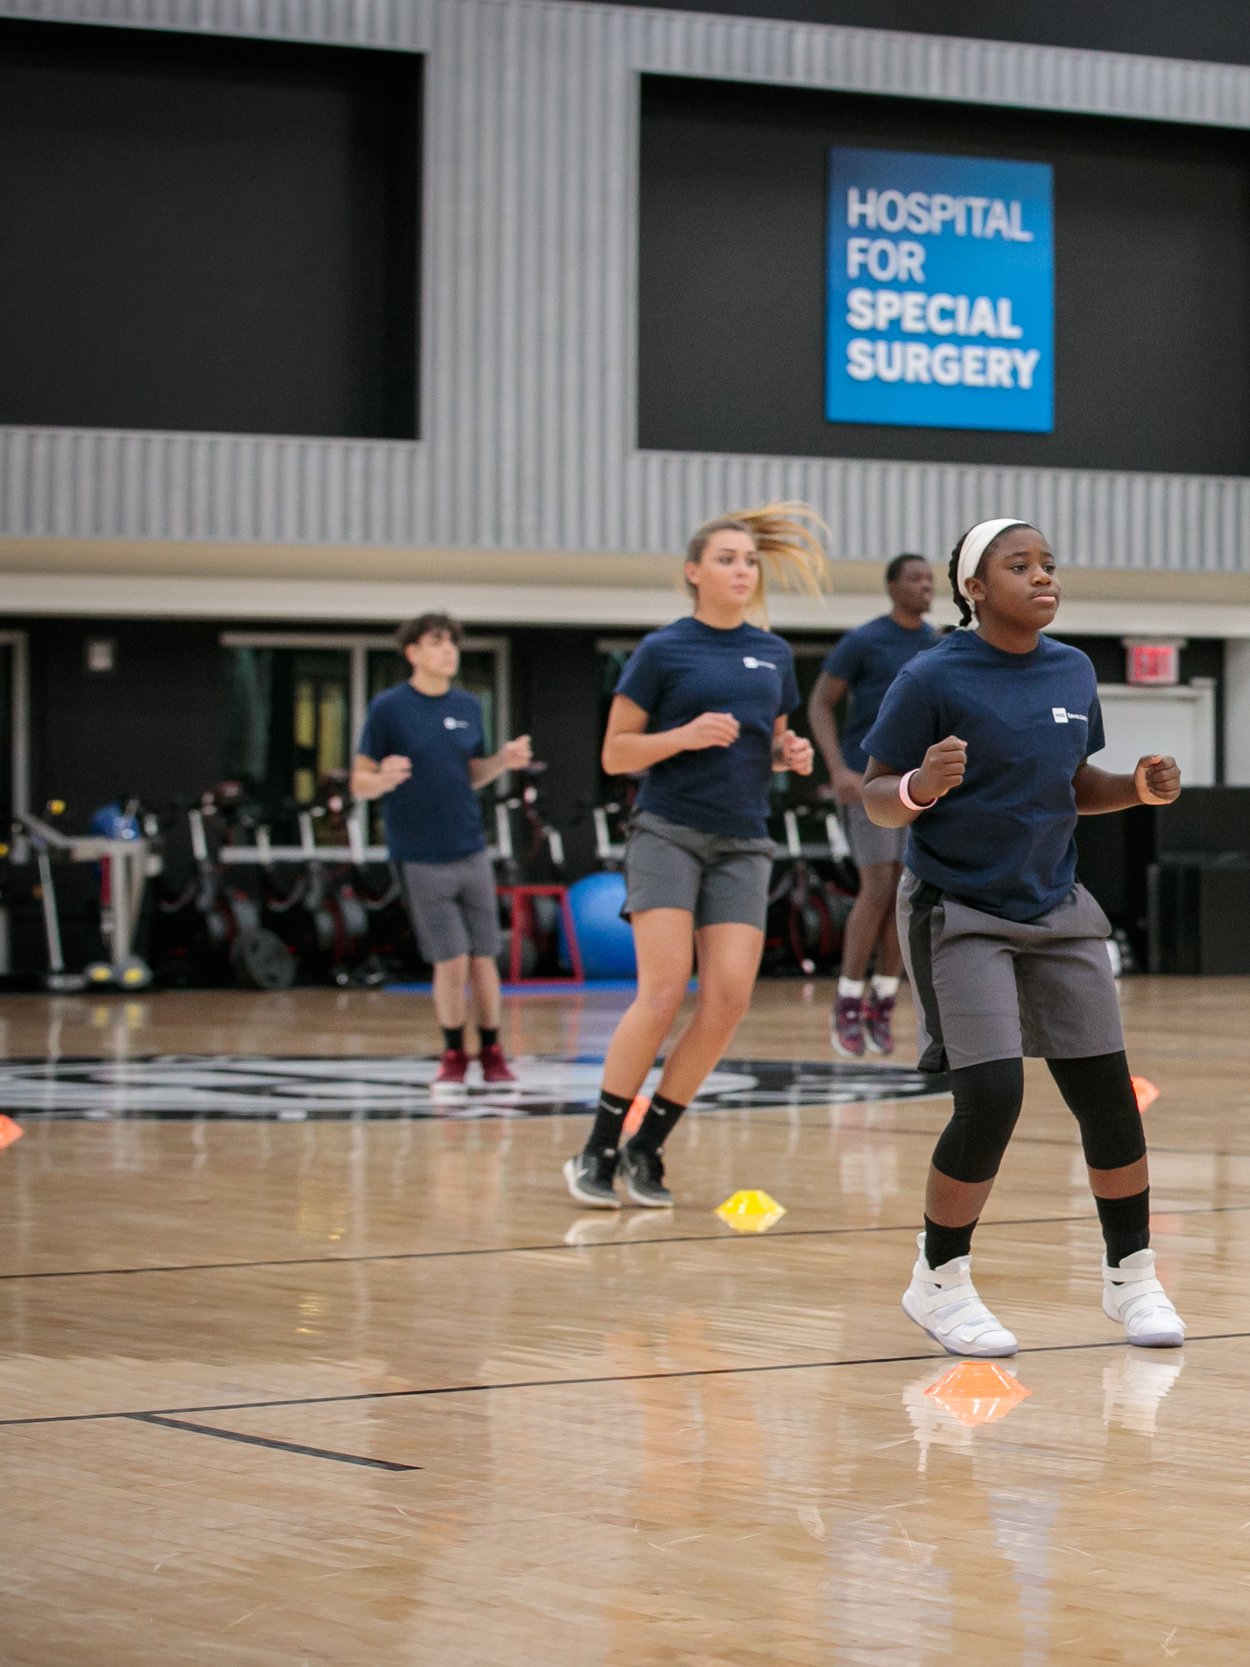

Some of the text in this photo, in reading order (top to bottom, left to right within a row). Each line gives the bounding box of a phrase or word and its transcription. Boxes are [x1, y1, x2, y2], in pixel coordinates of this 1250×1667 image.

[847, 186, 1034, 242] HOSPITAL
[847, 237, 925, 283] FOR
[846, 287, 1023, 340] SPECIAL
[846, 337, 1041, 390] SURGERY
